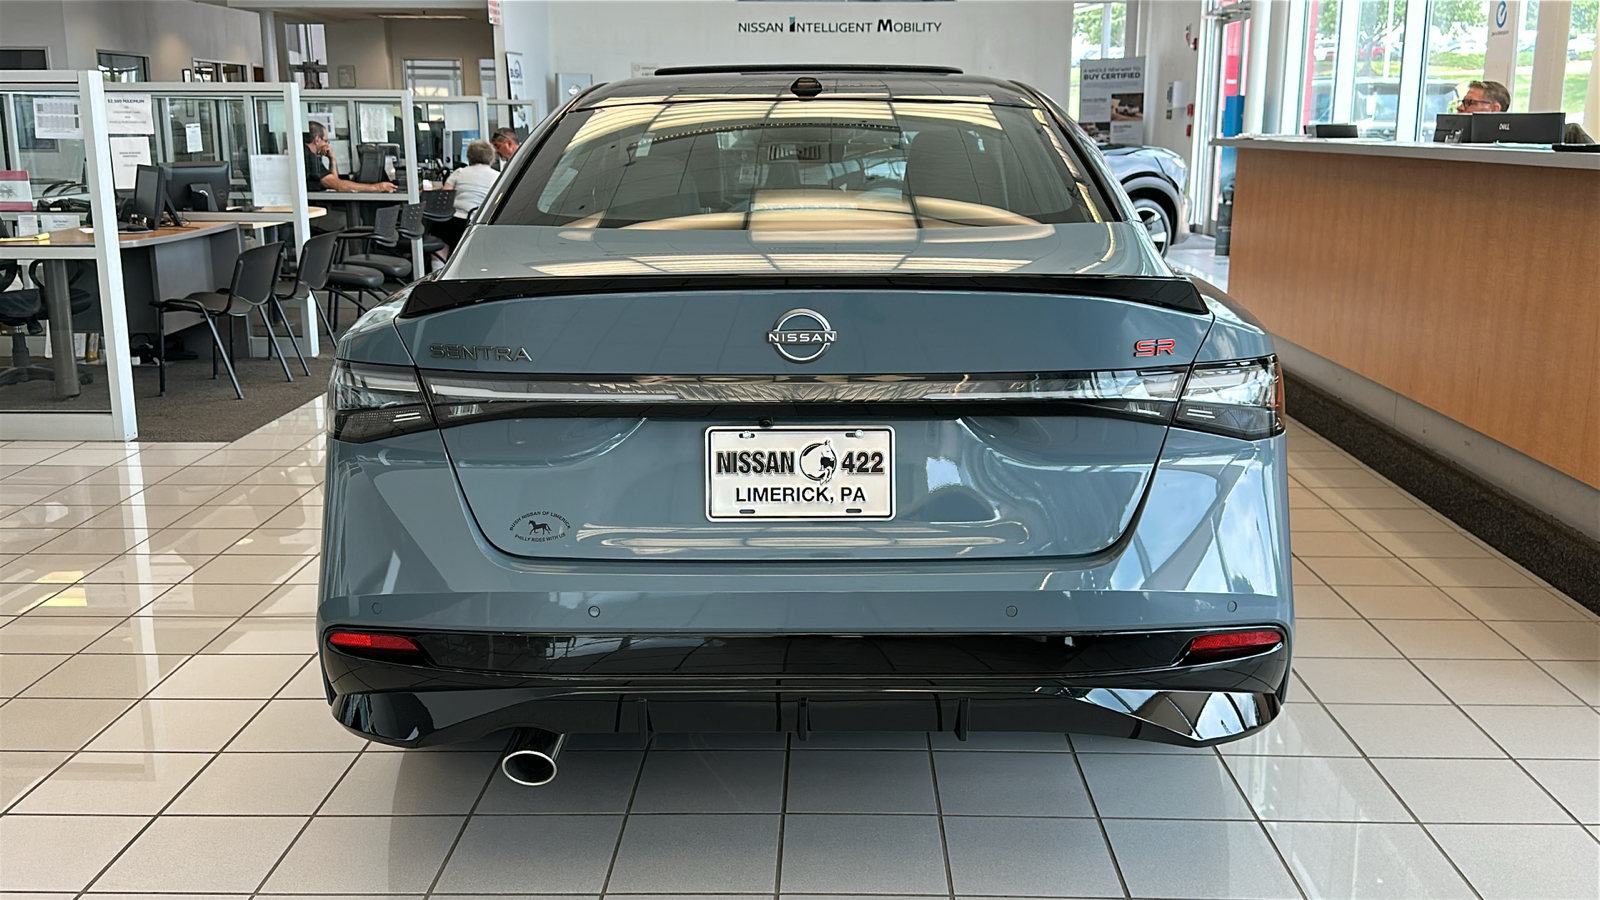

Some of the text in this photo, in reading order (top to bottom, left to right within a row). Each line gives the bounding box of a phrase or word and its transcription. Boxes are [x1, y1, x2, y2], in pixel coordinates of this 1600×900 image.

[738, 16, 942, 33] NISSAN INTELLIGENT MOBILITY
[1100, 72, 1141, 80] CERTIFIED
[768, 333, 835, 342] NISSAN
[429, 343, 533, 362] SENTRA
[1133, 338, 1176, 357] SR
[715, 450, 886, 475] NISSAN 422
[735, 486, 866, 504] LIMERICK, PA
[509, 517, 522, 531] BUSH
[521, 510, 541, 520] NISSAN
[550, 511, 571, 529] LIMERICK
[514, 533, 531, 541] PHILLY
